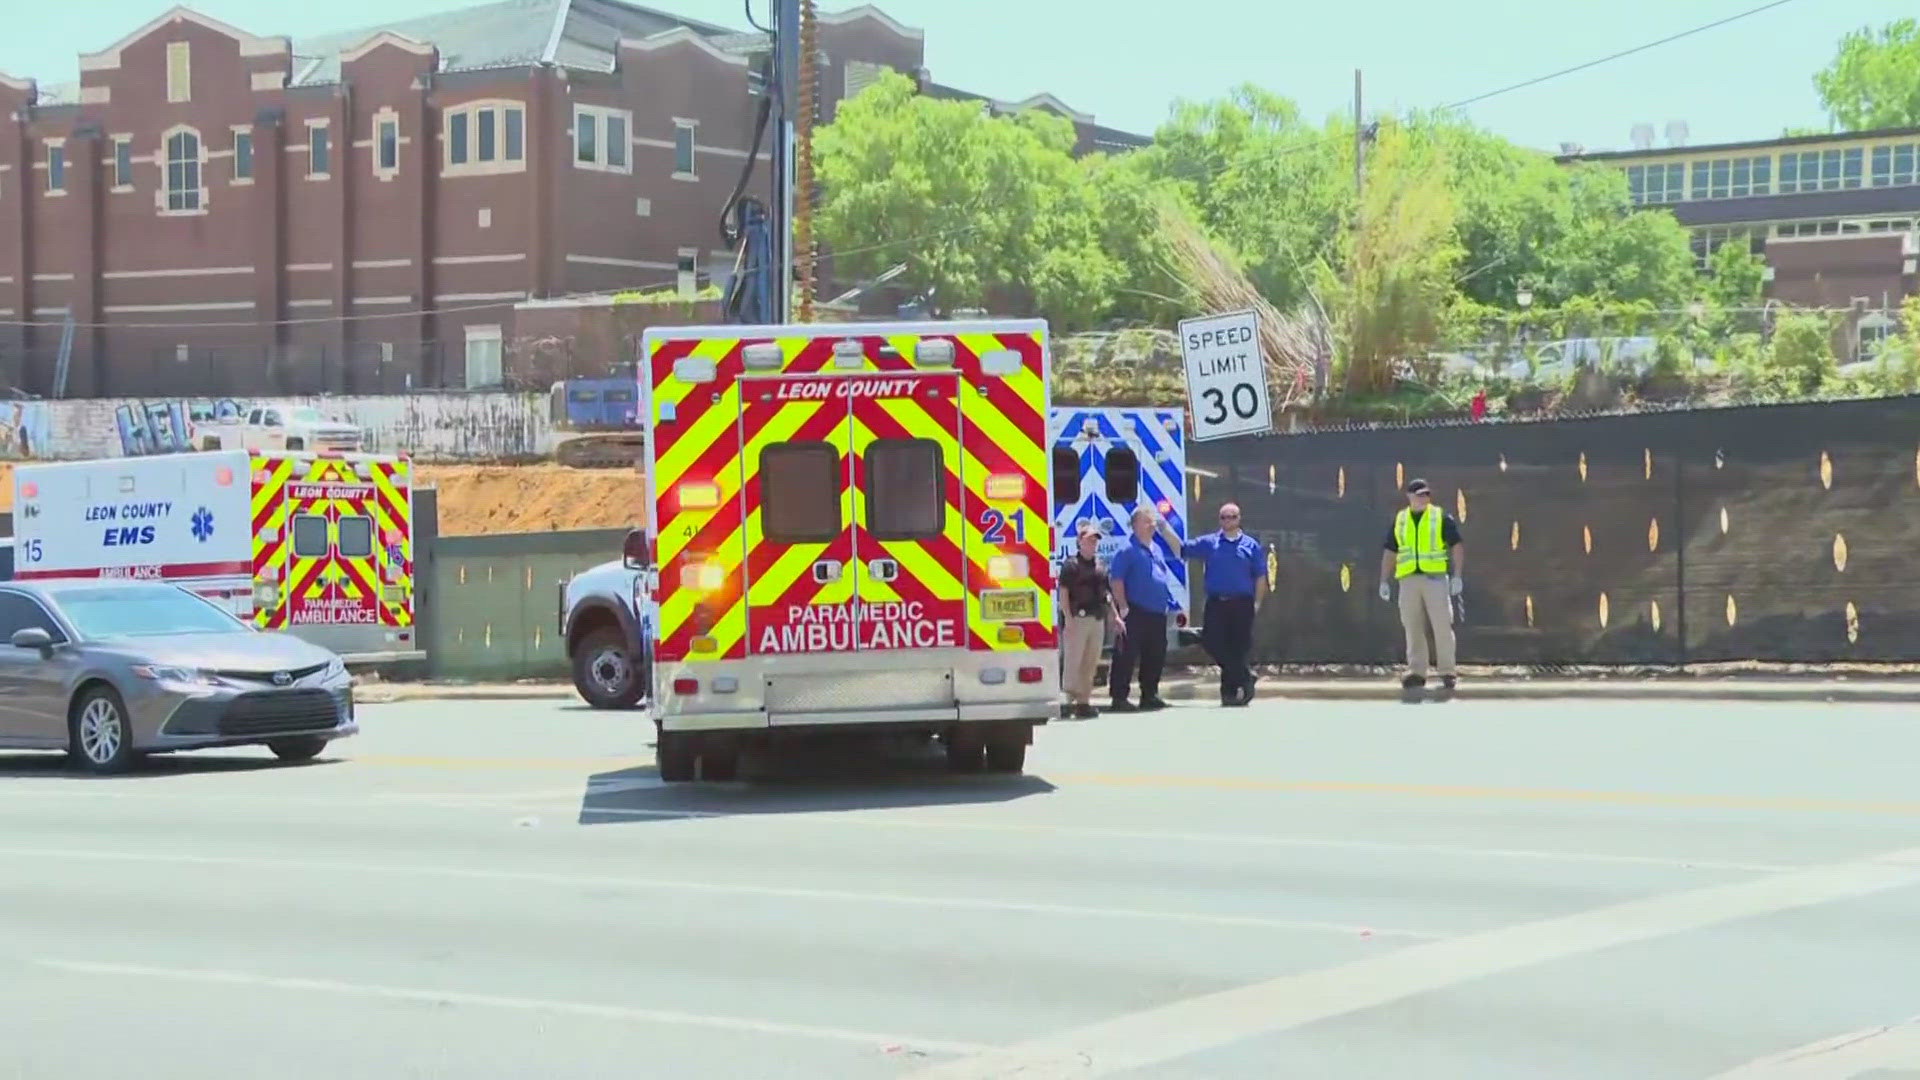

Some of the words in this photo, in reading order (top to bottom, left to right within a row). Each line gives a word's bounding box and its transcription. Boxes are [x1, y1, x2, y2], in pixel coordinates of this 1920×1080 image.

[1189, 327, 1252, 350] SPEED
[1199, 354, 1247, 376] LIMIT
[777, 382, 832, 399] LEON
[836, 379, 920, 398] COUNTY
[1202, 382, 1258, 425] 30
[294, 487, 322, 499] LEON
[326, 487, 369, 499] COUNTY
[86, 504, 117, 521] LEON
[121, 502, 172, 519] COUNTY
[103, 526, 155, 546] EMS
[981, 507, 1025, 544] 21
[23, 539, 42, 562] 15
[387, 544, 404, 567] 15
[99, 565, 162, 580] AMBULANCE
[304, 599, 362, 609] PARAMEDIC
[788, 601, 923, 624] PARAMEDIC
[292, 609, 375, 623] AMBULANCE
[760, 619, 955, 652] AMBULANCE
